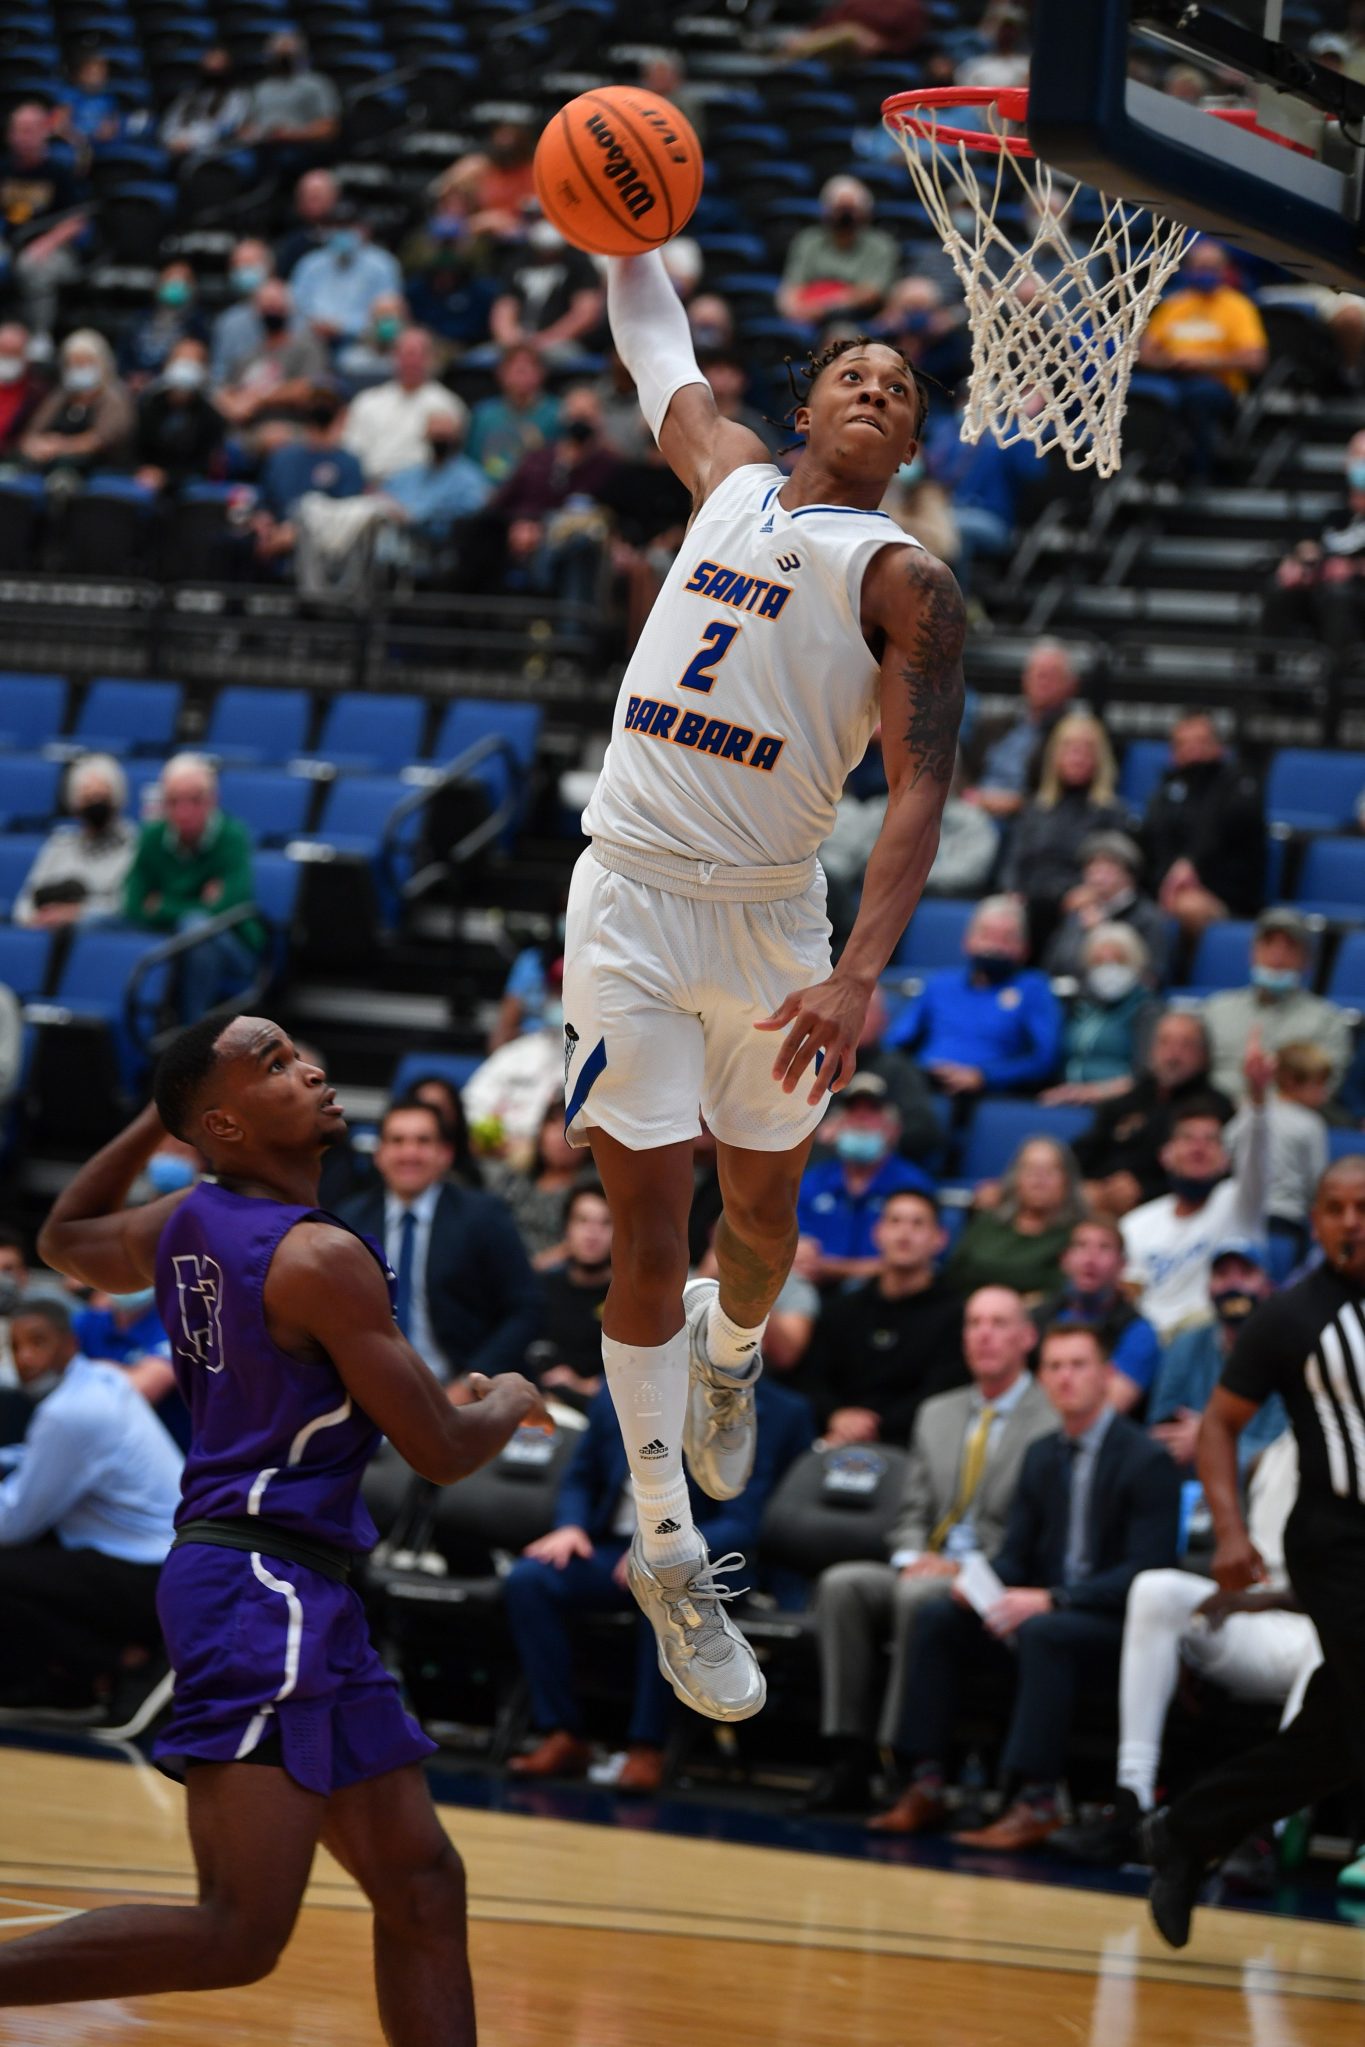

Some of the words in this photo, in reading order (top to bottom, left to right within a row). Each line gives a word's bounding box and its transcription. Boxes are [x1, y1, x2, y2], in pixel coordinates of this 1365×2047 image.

[586, 114, 656, 221] Wilson
[683, 559, 794, 622] SANTA
[677, 619, 743, 696] 2
[624, 694, 788, 776] BARBARA
[639, 1446, 668, 1455] adidas
[654, 1523, 681, 1534] adidas
